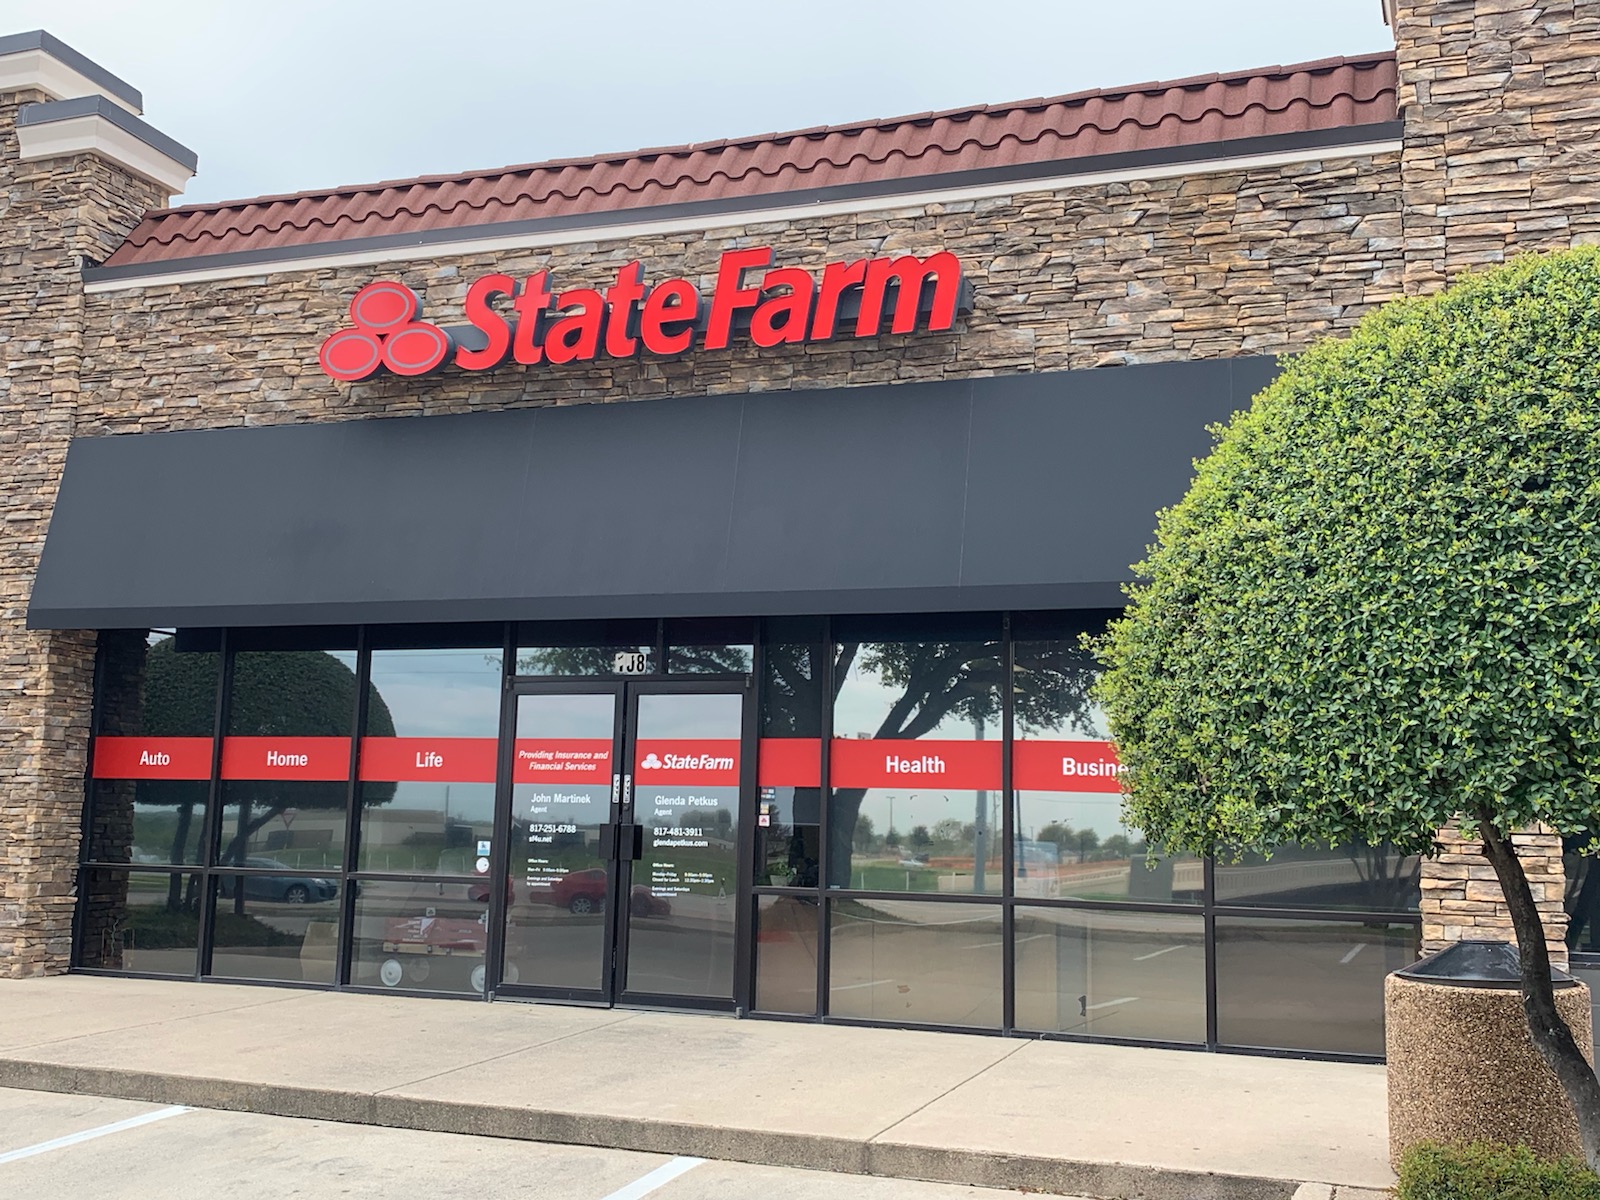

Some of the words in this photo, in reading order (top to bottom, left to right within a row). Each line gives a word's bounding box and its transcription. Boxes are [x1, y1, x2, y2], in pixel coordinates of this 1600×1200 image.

[139, 750, 170, 766] Auto
[266, 750, 308, 767] Home
[415, 752, 443, 768] Life
[518, 750, 554, 760] Providing
[555, 750, 592, 760] Insurance
[593, 751, 609, 760] and
[529, 762, 564, 771] Financial
[564, 762, 596, 771] Services
[885, 755, 946, 774] Health
[531, 793, 551, 803] John
[553, 793, 591, 804] Martinek
[654, 795, 686, 806] Glenda
[688, 795, 718, 807] Petkus
[530, 805, 548, 814] Agent
[654, 808, 673, 817] Agent
[529, 823, 577, 834] 817-251-6788
[653, 827, 703, 837] 817-481-3911
[652, 838, 709, 848] glendapetkus.com
